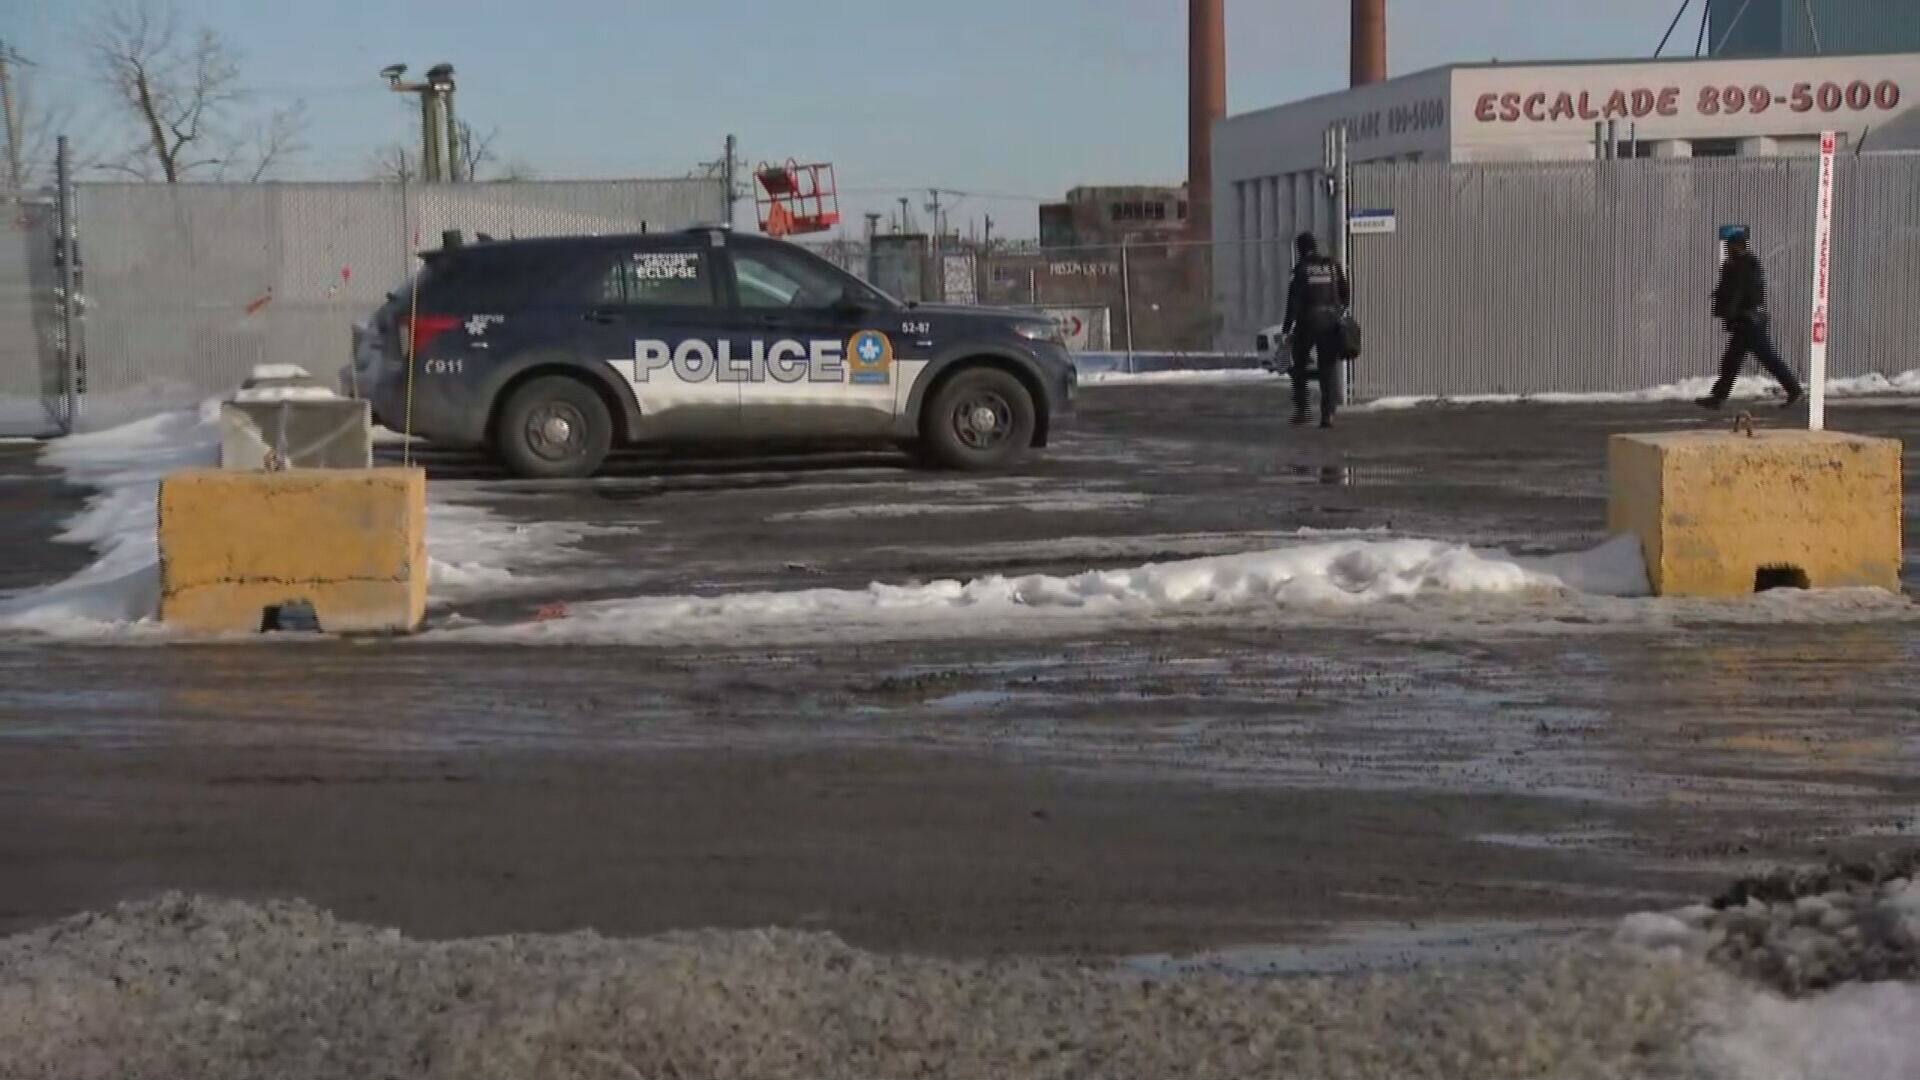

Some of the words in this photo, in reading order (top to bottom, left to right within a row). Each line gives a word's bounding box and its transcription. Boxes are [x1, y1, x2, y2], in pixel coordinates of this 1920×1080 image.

[1474, 86, 1680, 122] ESCALADE
[1696, 79, 1900, 116] 899-5000
[633, 338, 845, 384] POLICE
